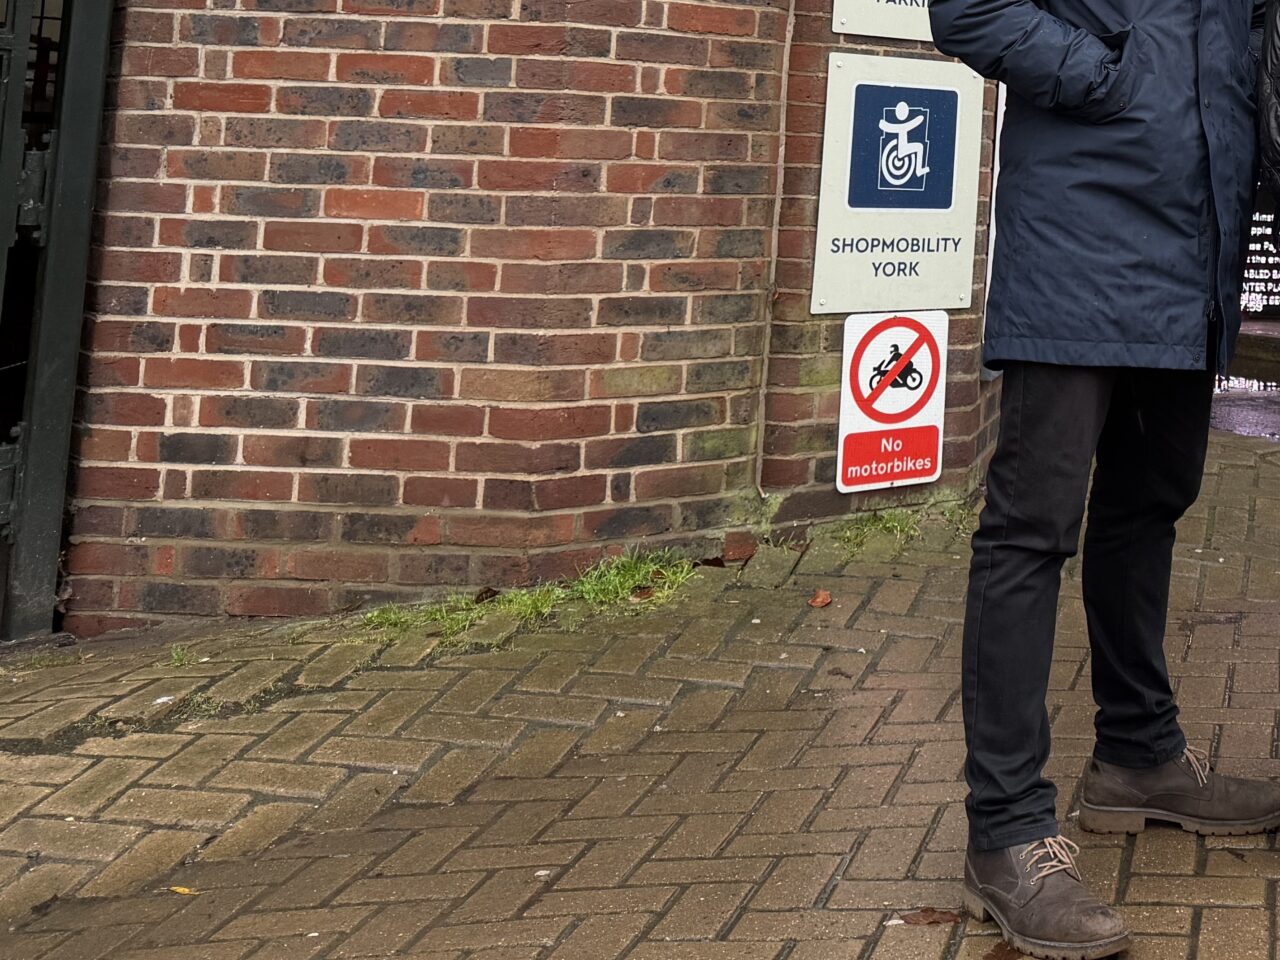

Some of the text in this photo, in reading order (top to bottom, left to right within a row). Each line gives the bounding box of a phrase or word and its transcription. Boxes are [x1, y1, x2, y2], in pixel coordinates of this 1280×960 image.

[830, 237, 962, 254] SHOPMOBILITY
[871, 261, 920, 278] YORK
[880, 437, 903, 453] No
[846, 456, 932, 479] motorbikes
